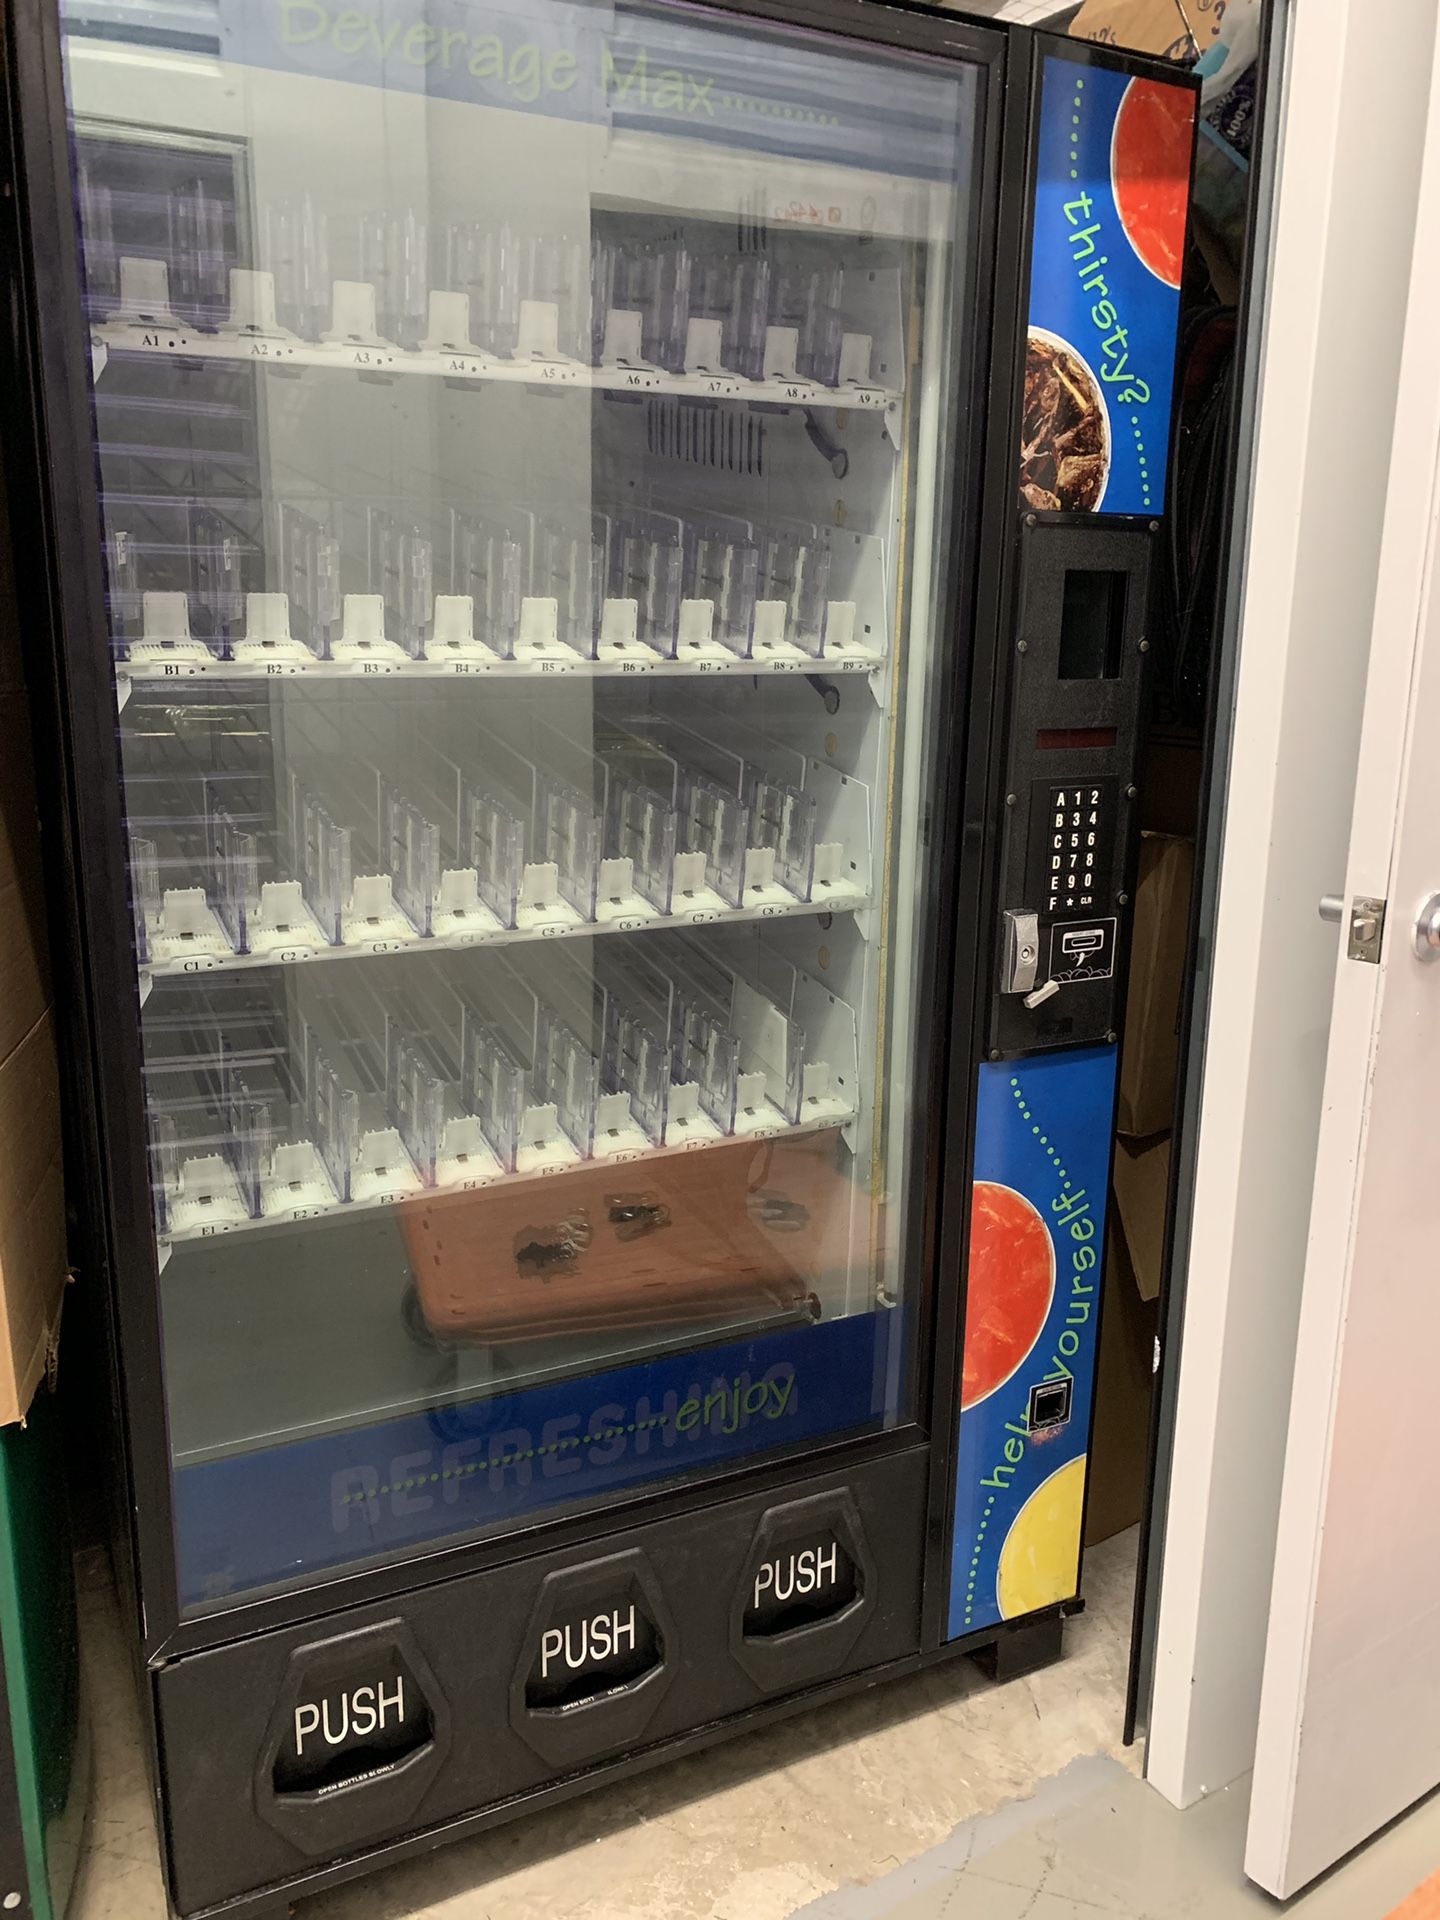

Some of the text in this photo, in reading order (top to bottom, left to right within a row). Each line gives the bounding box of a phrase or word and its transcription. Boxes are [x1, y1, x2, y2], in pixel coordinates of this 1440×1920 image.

[602, 38, 715, 117] Max
[1063, 191, 1151, 404] thirsty?
[142, 335, 871, 404] A1 A2 A3 A4 A5 A6 A7 A8 A9
[164, 661, 855, 676] B1 B2 B3 B4 B5 B6 B7 B8 B9
[1056, 790, 1099, 807] A 1 2
[1055, 811, 1097, 828] B 3 4
[1053, 832, 1096, 849] C 5 6
[1052, 852, 1094, 870] D 7 8
[1050, 873, 1092, 890] E 9 0
[1049, 896, 1092, 911] F CLR
[183, 961, 200, 972] C1
[280, 950, 297, 962] C2
[372, 942, 388, 953] C3
[459, 935, 475, 945] C4
[541, 927, 556, 938] C5
[618, 920, 633, 931] C6
[692, 913, 706, 924] C7
[762, 907, 775, 917] C8
[202, 1226, 216, 1236] E1
[675, 1374, 794, 1434] enjoy
[980, 1401, 1032, 1488] hel
[754, 1542, 837, 1609] PUSH
[541, 1605, 635, 1678] PUSH
[294, 1675, 404, 1756] PUSH
[562, 1701, 580, 1711] OPEN
[318, 1763, 396, 1795] OPEN BOTTLES SLOWLY
